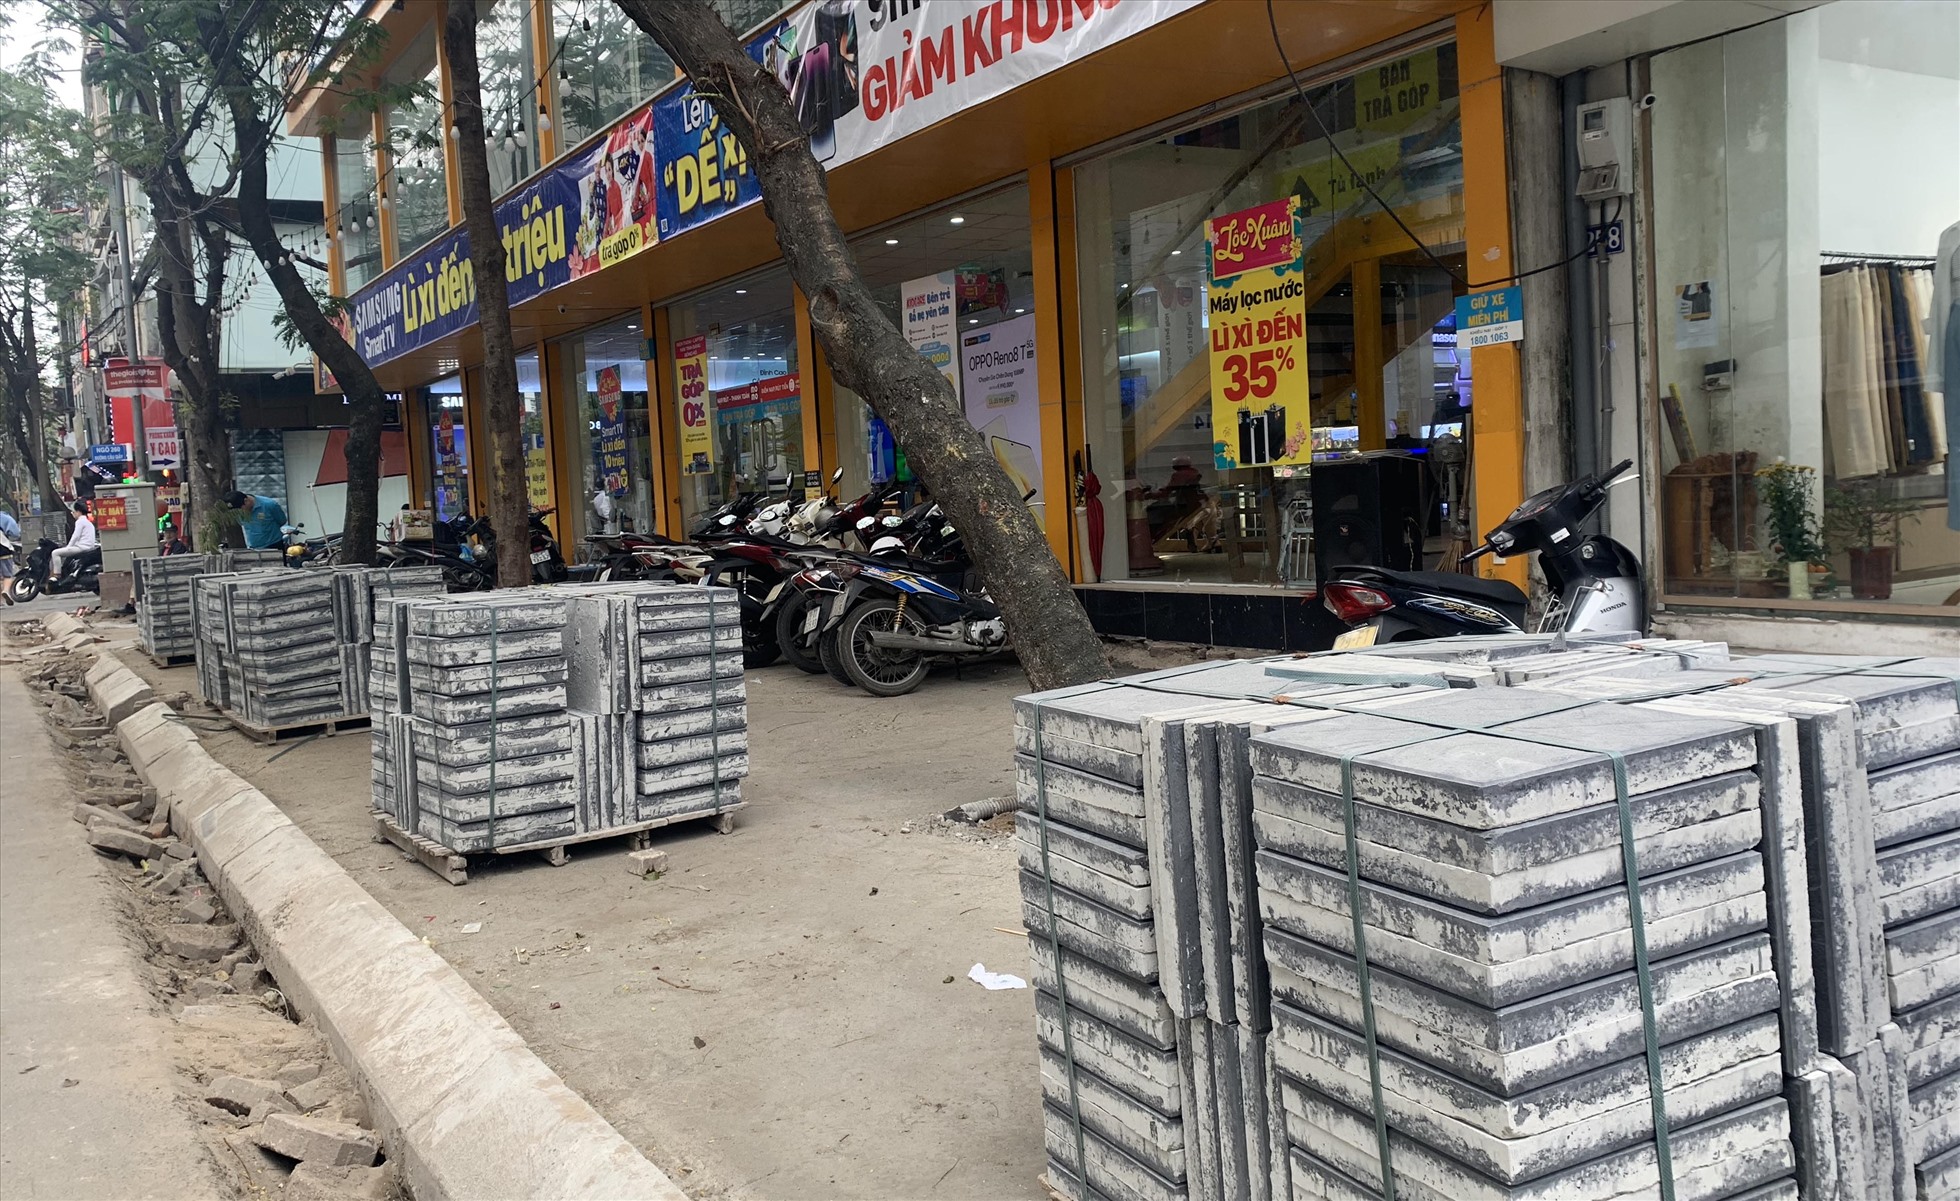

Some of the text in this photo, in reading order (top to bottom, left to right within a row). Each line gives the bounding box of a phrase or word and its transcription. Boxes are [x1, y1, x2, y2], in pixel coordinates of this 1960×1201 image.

[862, 29, 956, 122] GIẢM
[501, 196, 566, 287] triệu
[602, 238, 613, 261] trả
[613, 234, 629, 260] góp
[1215, 213, 1291, 262] Lộc Xuân
[355, 281, 401, 335] SAMSUNG
[1210, 278, 1303, 315] Máy lọc nước
[1471, 293, 1505, 309] GIỮ XE
[1213, 307, 1303, 353] LÌ XÌ ĐẾN
[1467, 306, 1509, 327] MIỄN PHÍ
[364, 323, 395, 360] Smart TV
[1470, 331, 1509, 345] 1800 1063
[680, 358, 704, 381] TRẢ
[969, 352, 993, 371] OPPO
[993, 346, 1019, 366] Reno8
[1020, 344, 1026, 360] T
[1222, 345, 1295, 402] 35%
[681, 379, 705, 399] GÓP
[158, 442, 177, 455] CAO
[97, 508, 107, 516] XE
[108, 506, 124, 516] MÁY
[1600, 601, 1627, 614] HONDA
